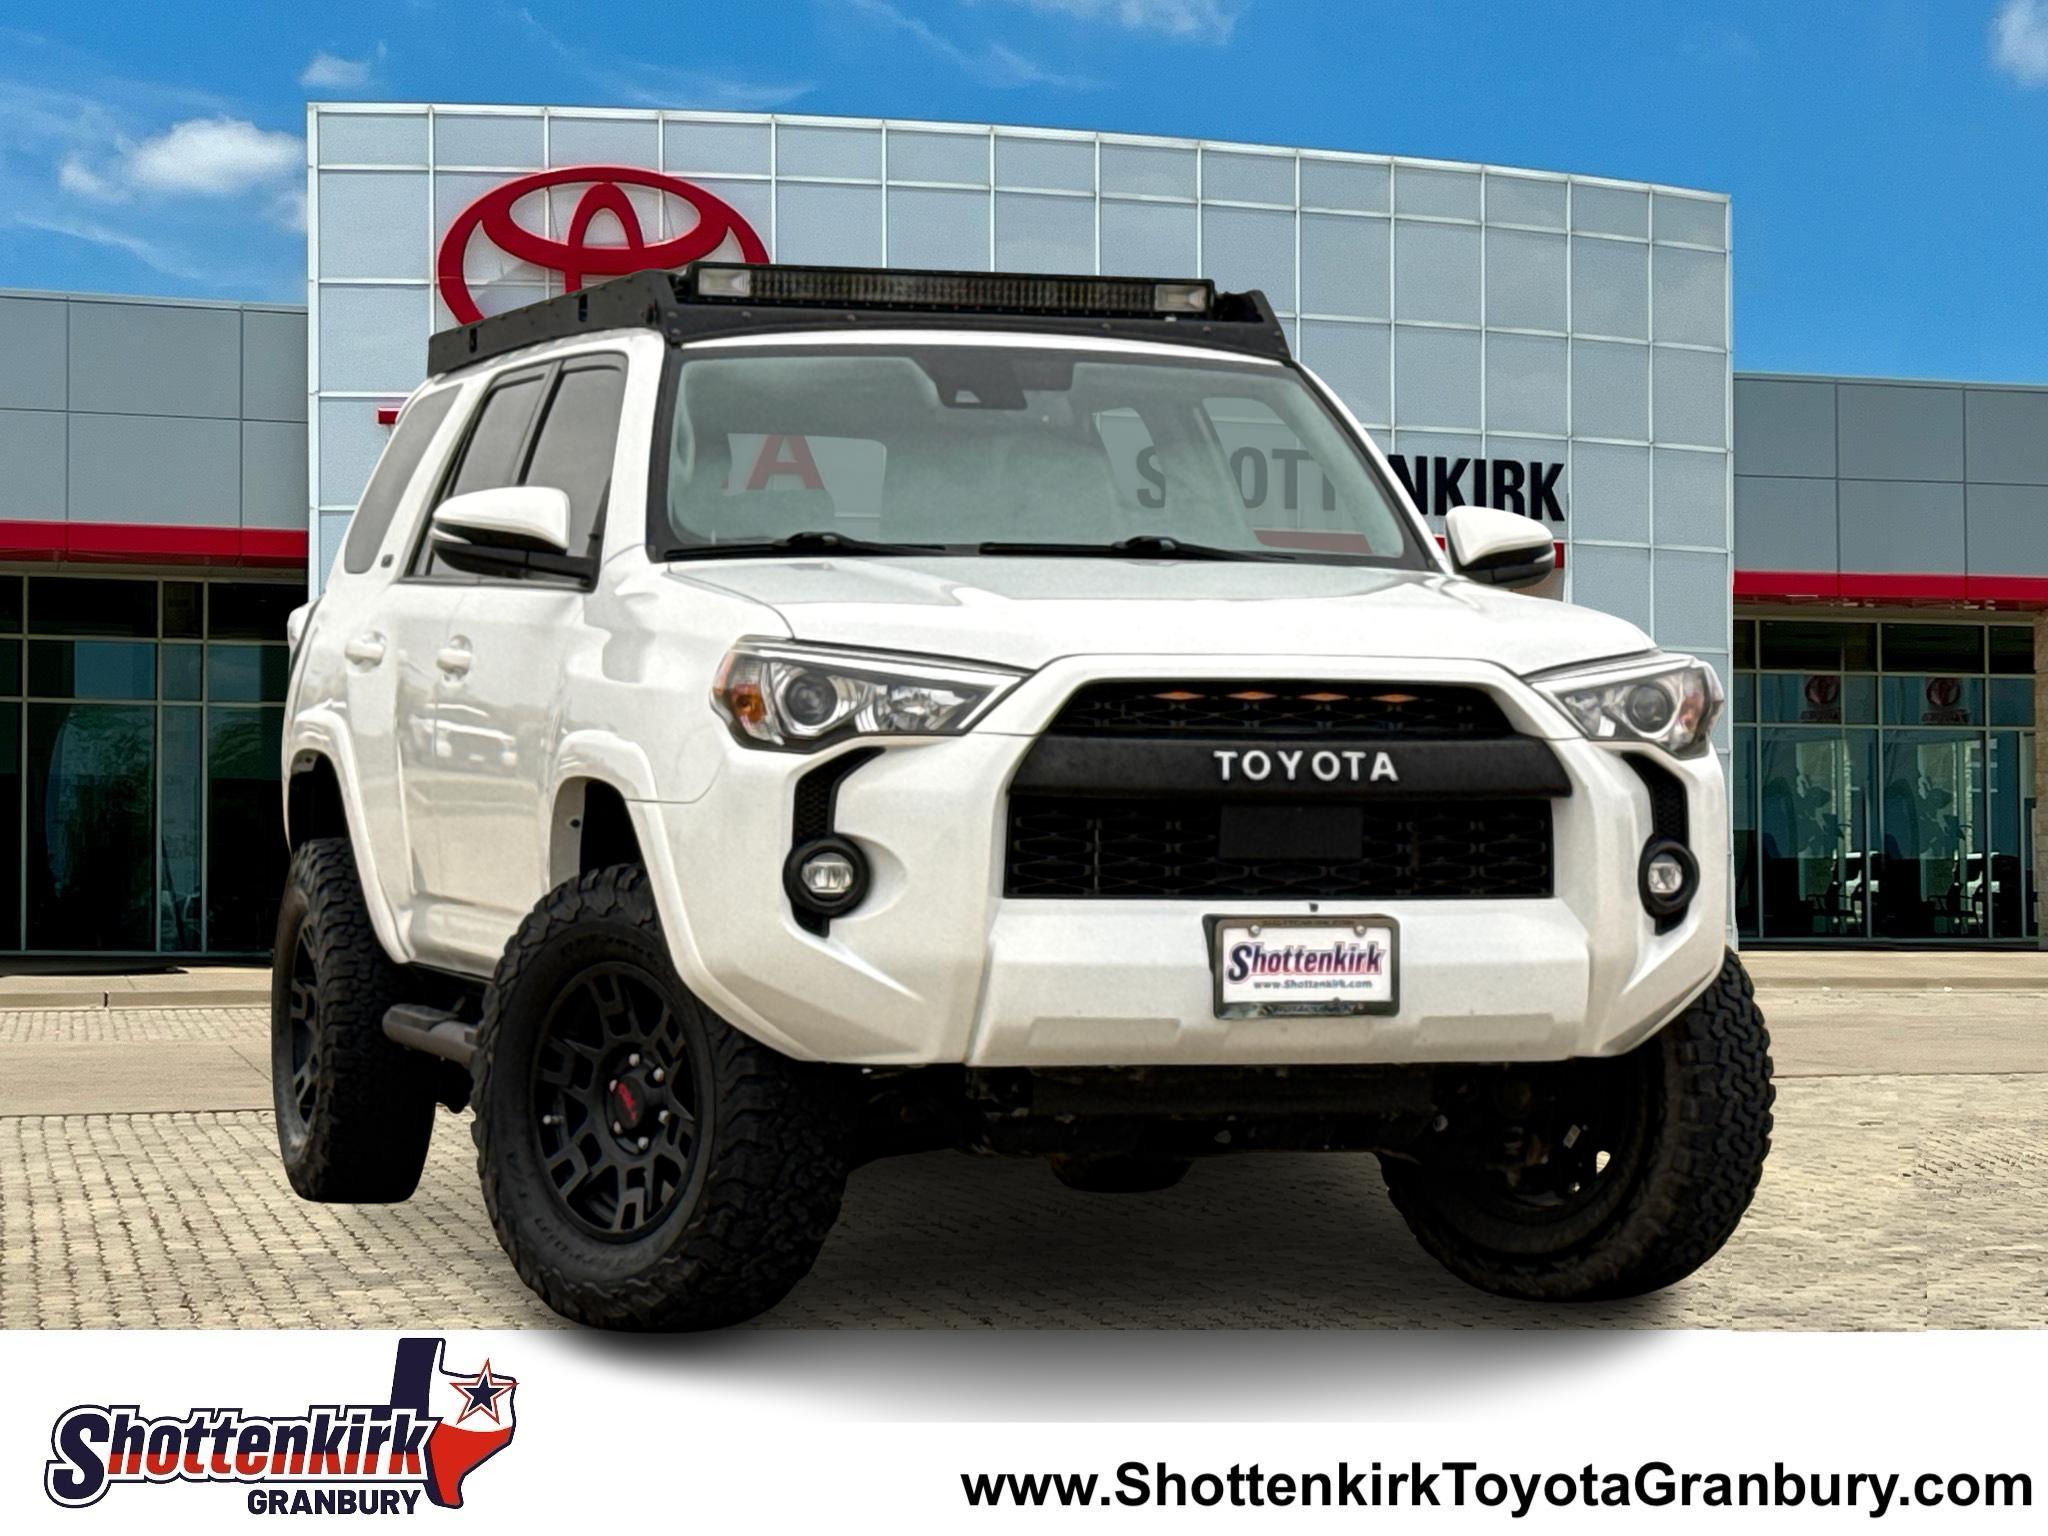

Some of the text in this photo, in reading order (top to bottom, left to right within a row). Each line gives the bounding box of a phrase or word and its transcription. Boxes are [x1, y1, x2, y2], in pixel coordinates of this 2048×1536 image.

[1136, 446, 1566, 522] SOTNKIRK
[1213, 750, 1399, 781] TOYOTA
[1227, 942, 1384, 982] Shottenkirk
